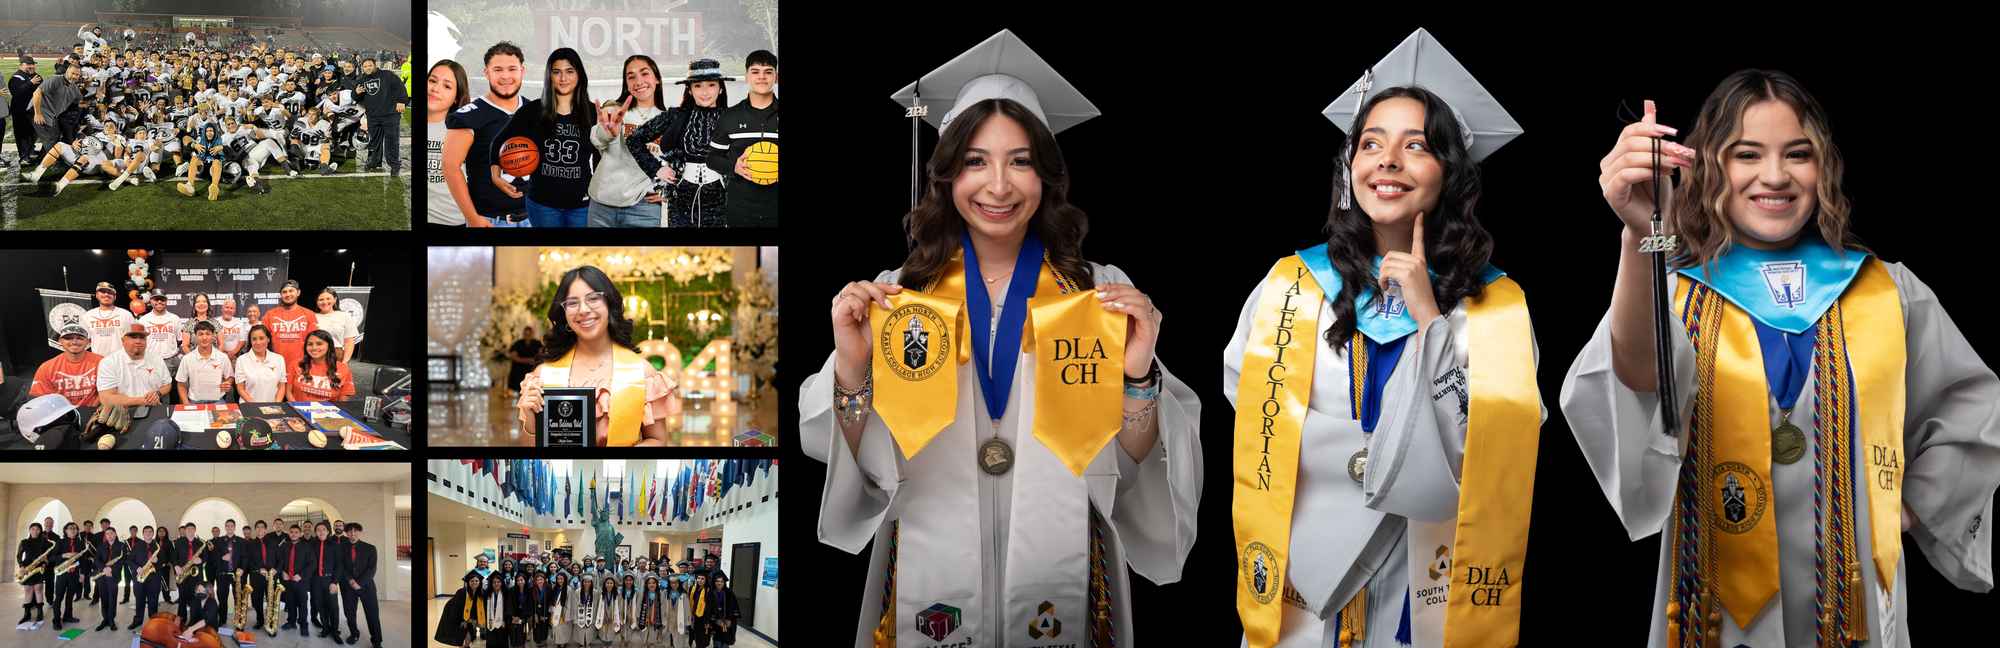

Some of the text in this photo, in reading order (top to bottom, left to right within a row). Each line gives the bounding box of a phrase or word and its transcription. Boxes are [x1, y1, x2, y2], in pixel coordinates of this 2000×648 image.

[550, 15, 696, 56] NORTH
[544, 138, 580, 165] 33
[542, 163, 582, 179] NORTH
[90, 319, 121, 329] TEXAS
[272, 321, 308, 333] TEXAS
[1054, 338, 1108, 362] DLA
[55, 375, 97, 390] TEXAS
[1061, 363, 1098, 385] CH
[1257, 267, 1309, 492] VALEDICTORIAN
[154, 435, 164, 449] 21
[1873, 445, 1899, 469] DLA
[1878, 469, 1893, 491] CH
[1466, 566, 1510, 586] DLA
[1416, 585, 1444, 599] SOUTH
[1426, 596, 1447, 606] COLL
[1471, 587, 1503, 607] CH
[917, 610, 961, 637] PSJA
